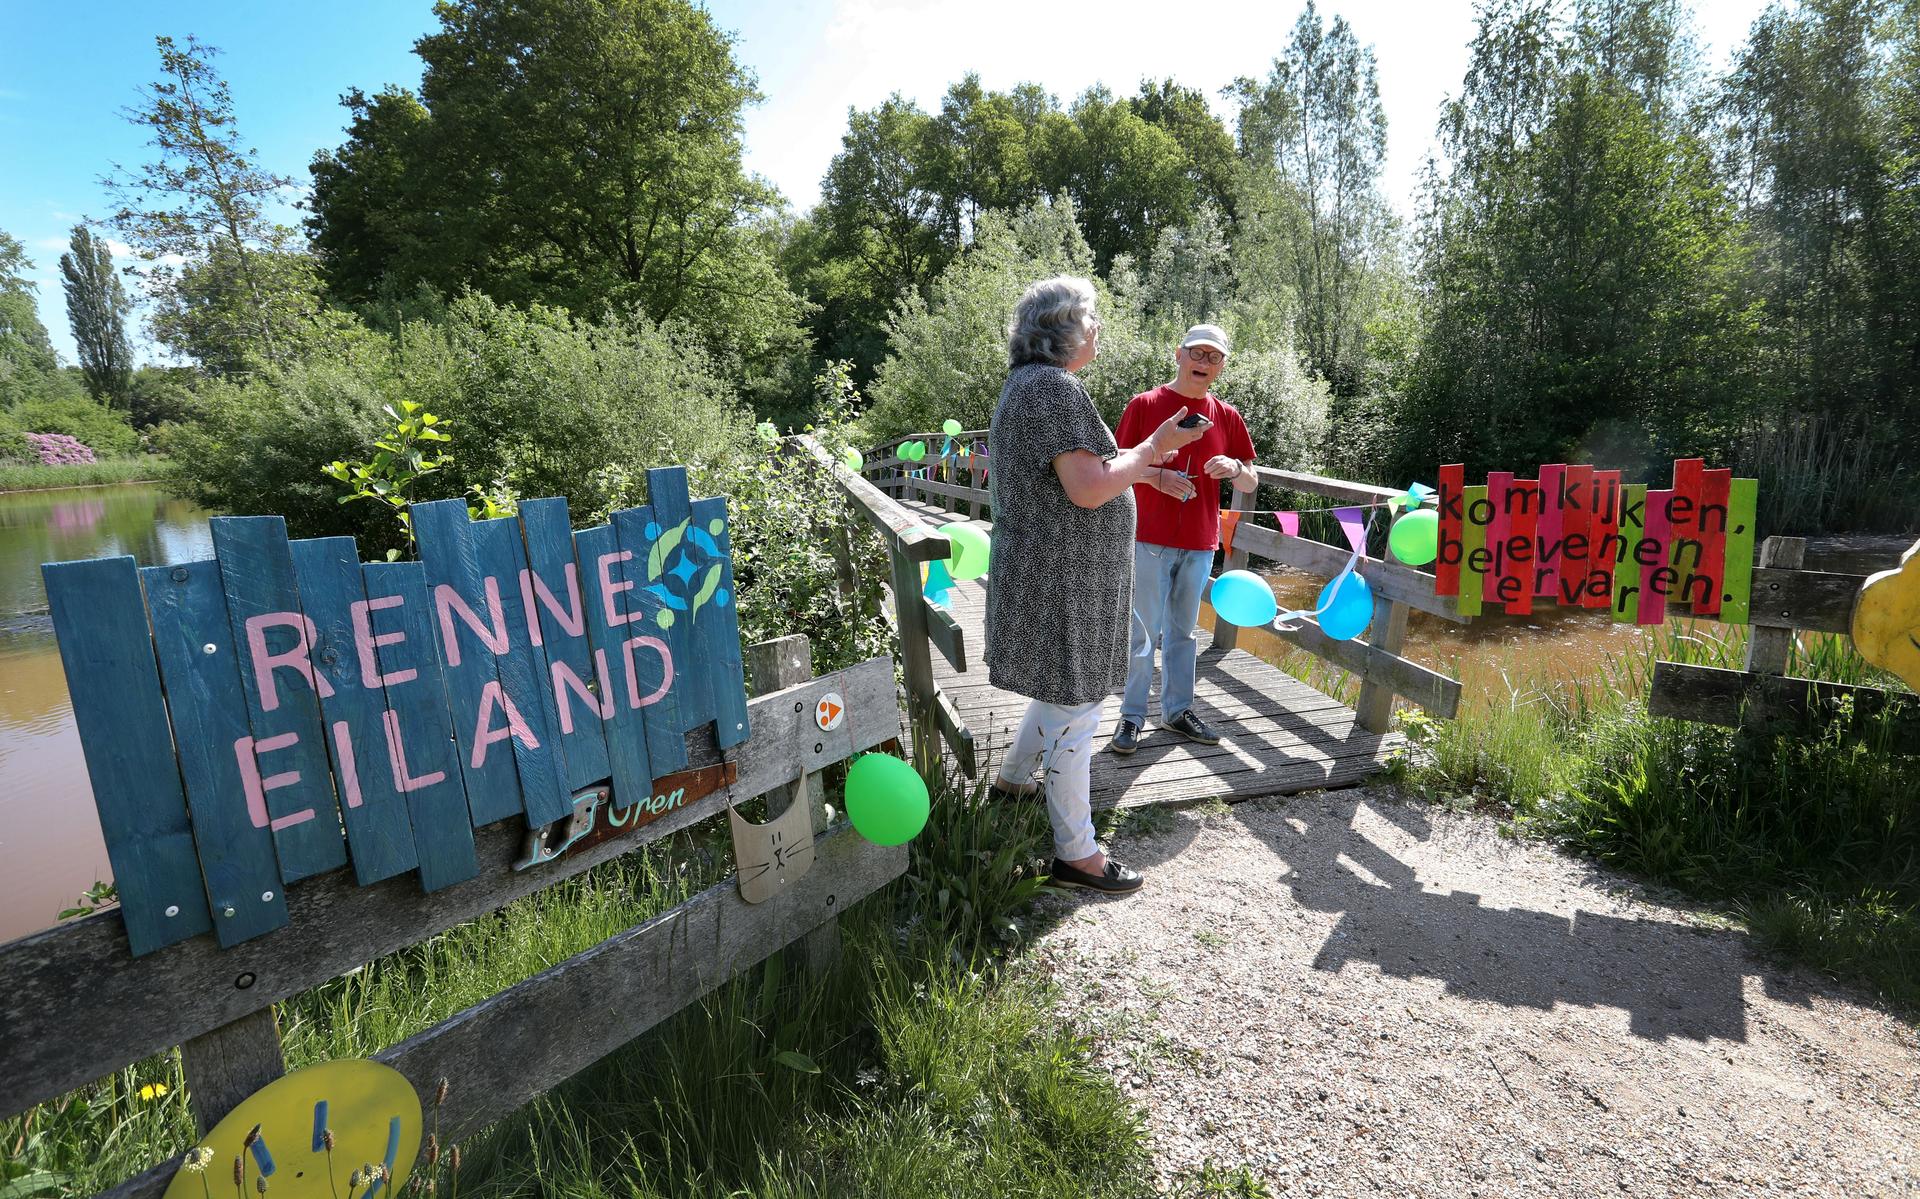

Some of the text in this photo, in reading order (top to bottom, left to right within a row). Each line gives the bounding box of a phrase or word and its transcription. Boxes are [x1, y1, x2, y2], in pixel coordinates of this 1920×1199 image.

[245, 551, 643, 711] RENNE
[1496, 566, 1733, 613] ervaren.
[234, 636, 675, 831] EILAND
